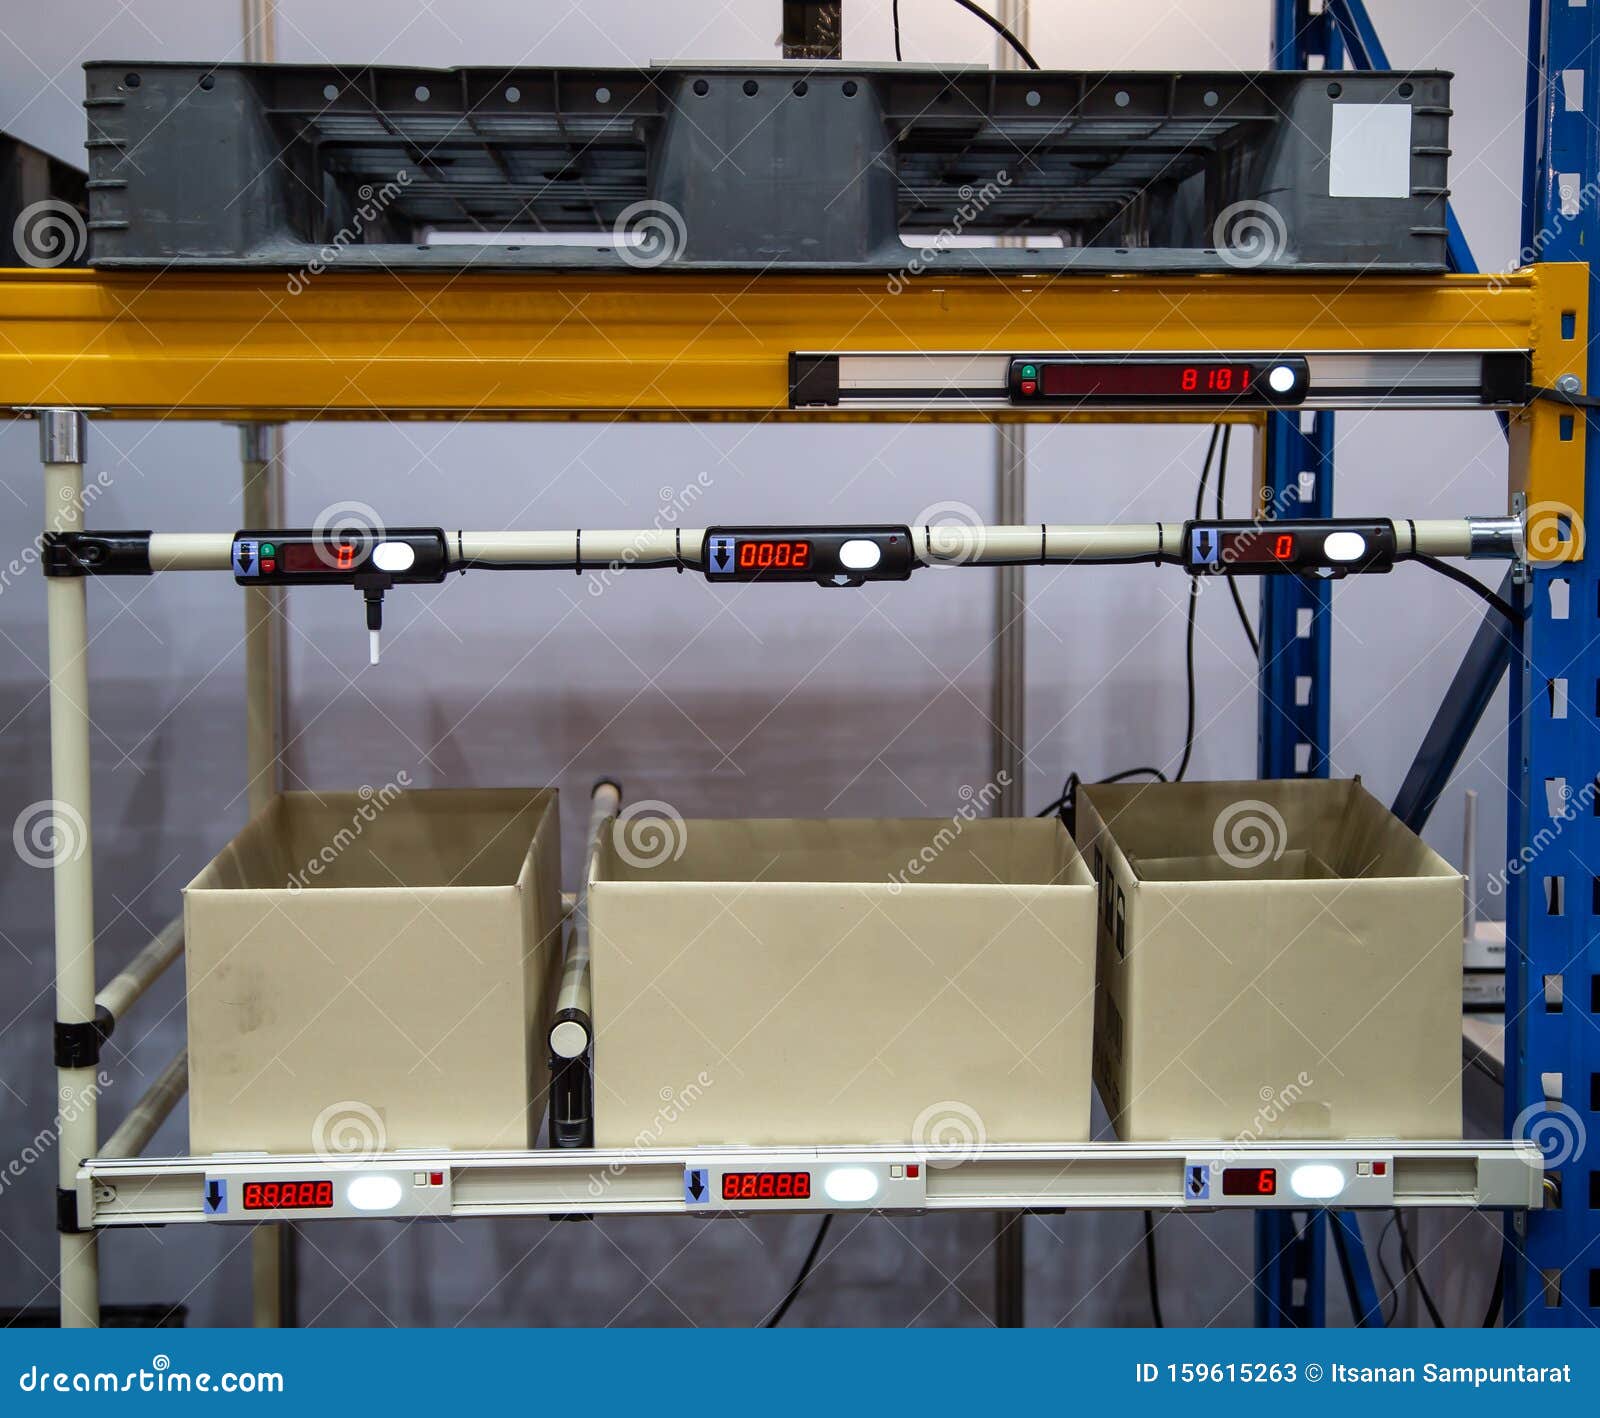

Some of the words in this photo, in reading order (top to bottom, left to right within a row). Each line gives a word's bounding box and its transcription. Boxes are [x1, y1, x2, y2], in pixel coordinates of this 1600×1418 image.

[1181, 368, 1250, 390] 8101
[740, 543, 808, 567] 0002
[1275, 535, 1293, 559] 0
[1258, 1169, 1275, 1193] 6
